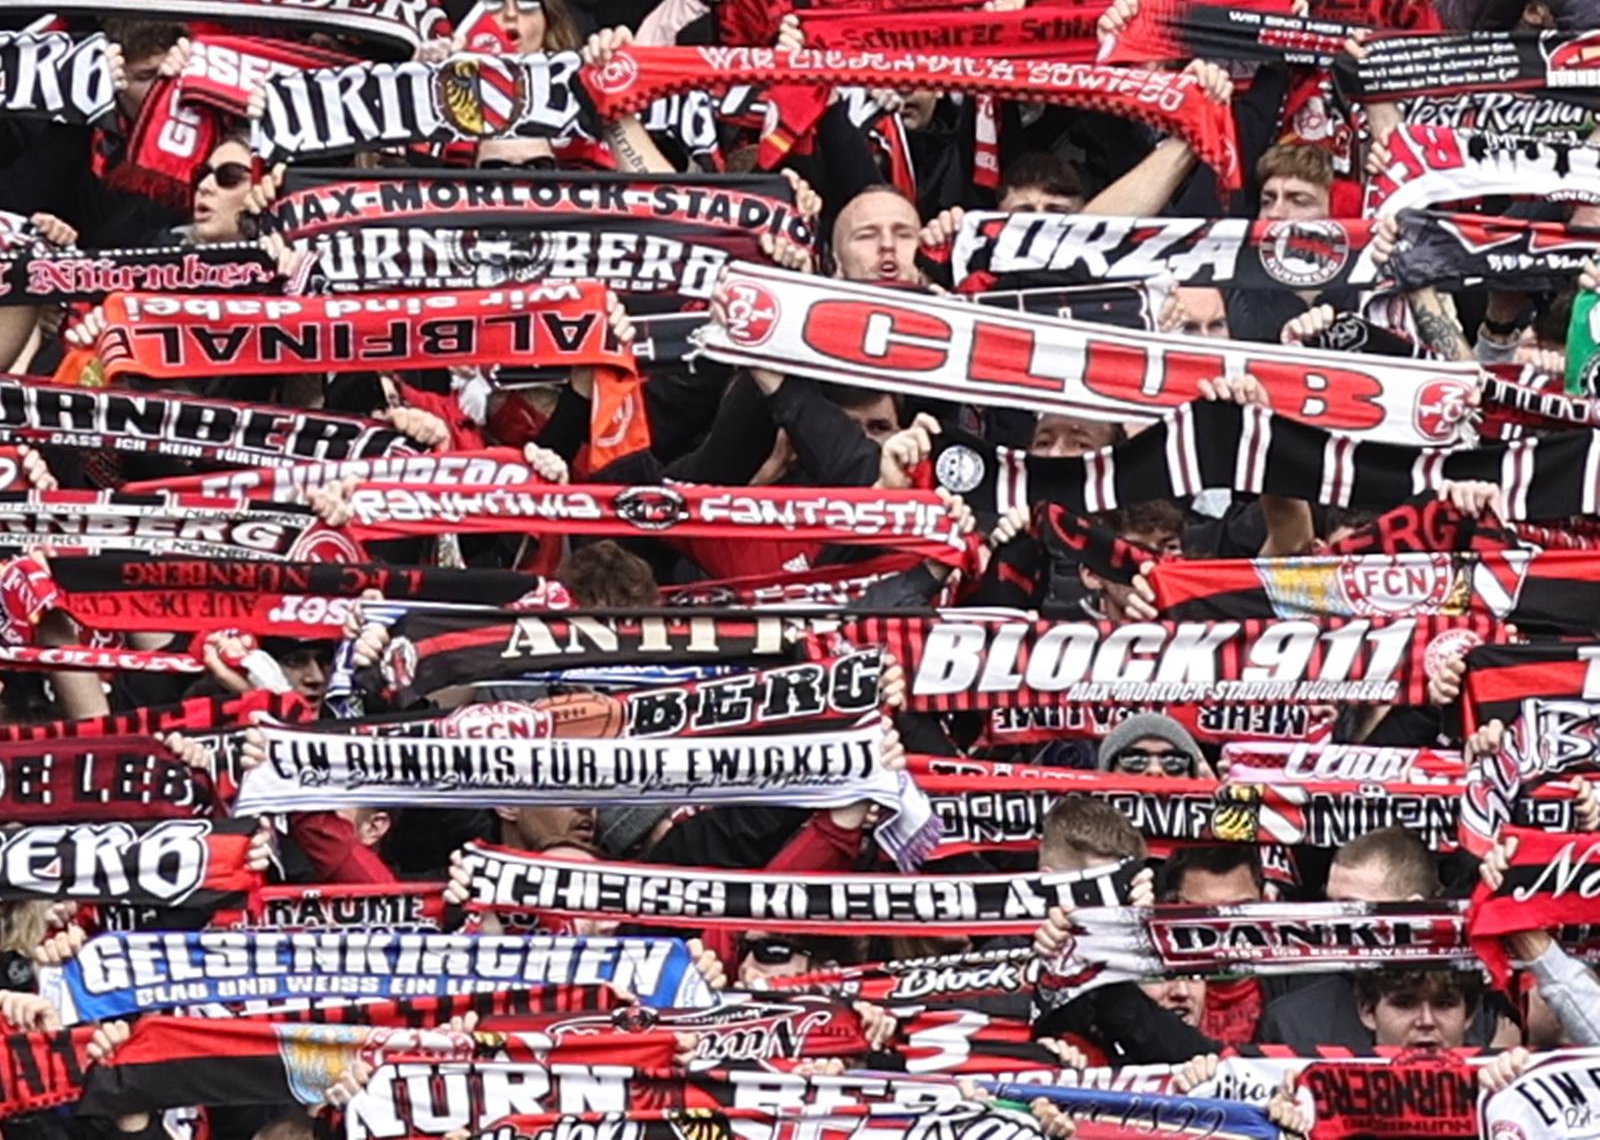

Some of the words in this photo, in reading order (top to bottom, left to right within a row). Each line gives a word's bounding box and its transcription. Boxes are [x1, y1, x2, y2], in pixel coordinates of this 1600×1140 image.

[805, 298, 1385, 431] CLUB
[1362, 568, 1430, 598] FCN
[629, 649, 883, 737] BERG
[913, 620, 1237, 697] BLOCK
[1243, 620, 1418, 701] 911
[269, 739, 329, 780] EIN
[345, 739, 517, 785] BÜNDNIS
[529, 740, 598, 785] FÜR
[612, 745, 670, 785] DIE
[685, 739, 874, 779] EWIGKEIT
[79, 931, 671, 996] GELSENKIRCHEN
[286, 977, 380, 994] WEISS
